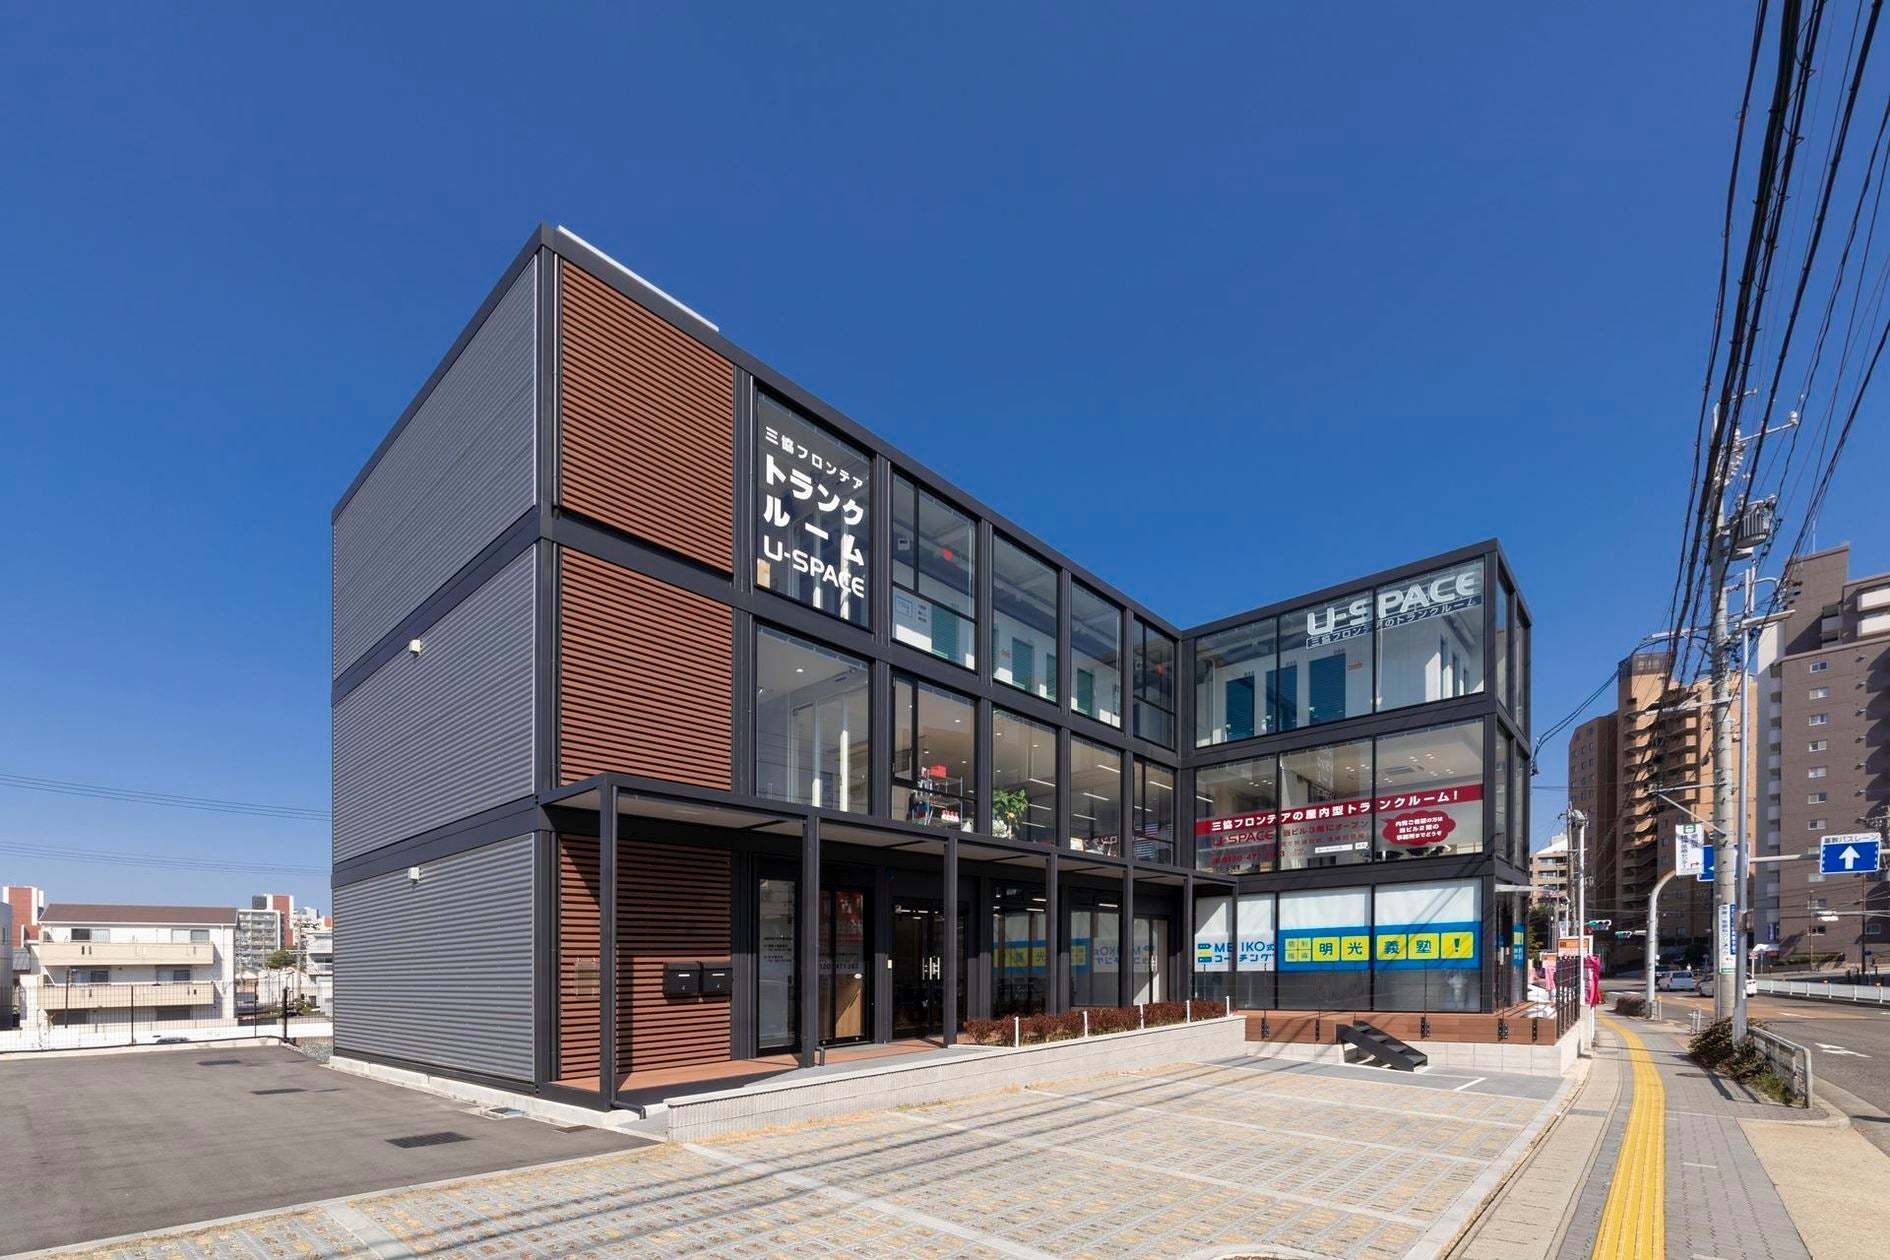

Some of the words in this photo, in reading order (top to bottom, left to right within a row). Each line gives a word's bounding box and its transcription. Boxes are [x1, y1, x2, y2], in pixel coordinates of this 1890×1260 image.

[765, 425, 863, 489] 三協フロンテア
[766, 453, 864, 525] トランク
[763, 494, 865, 566] ルーム
[763, 535, 865, 598] U-SPACE
[1307, 571, 1475, 636] U-SPACE
